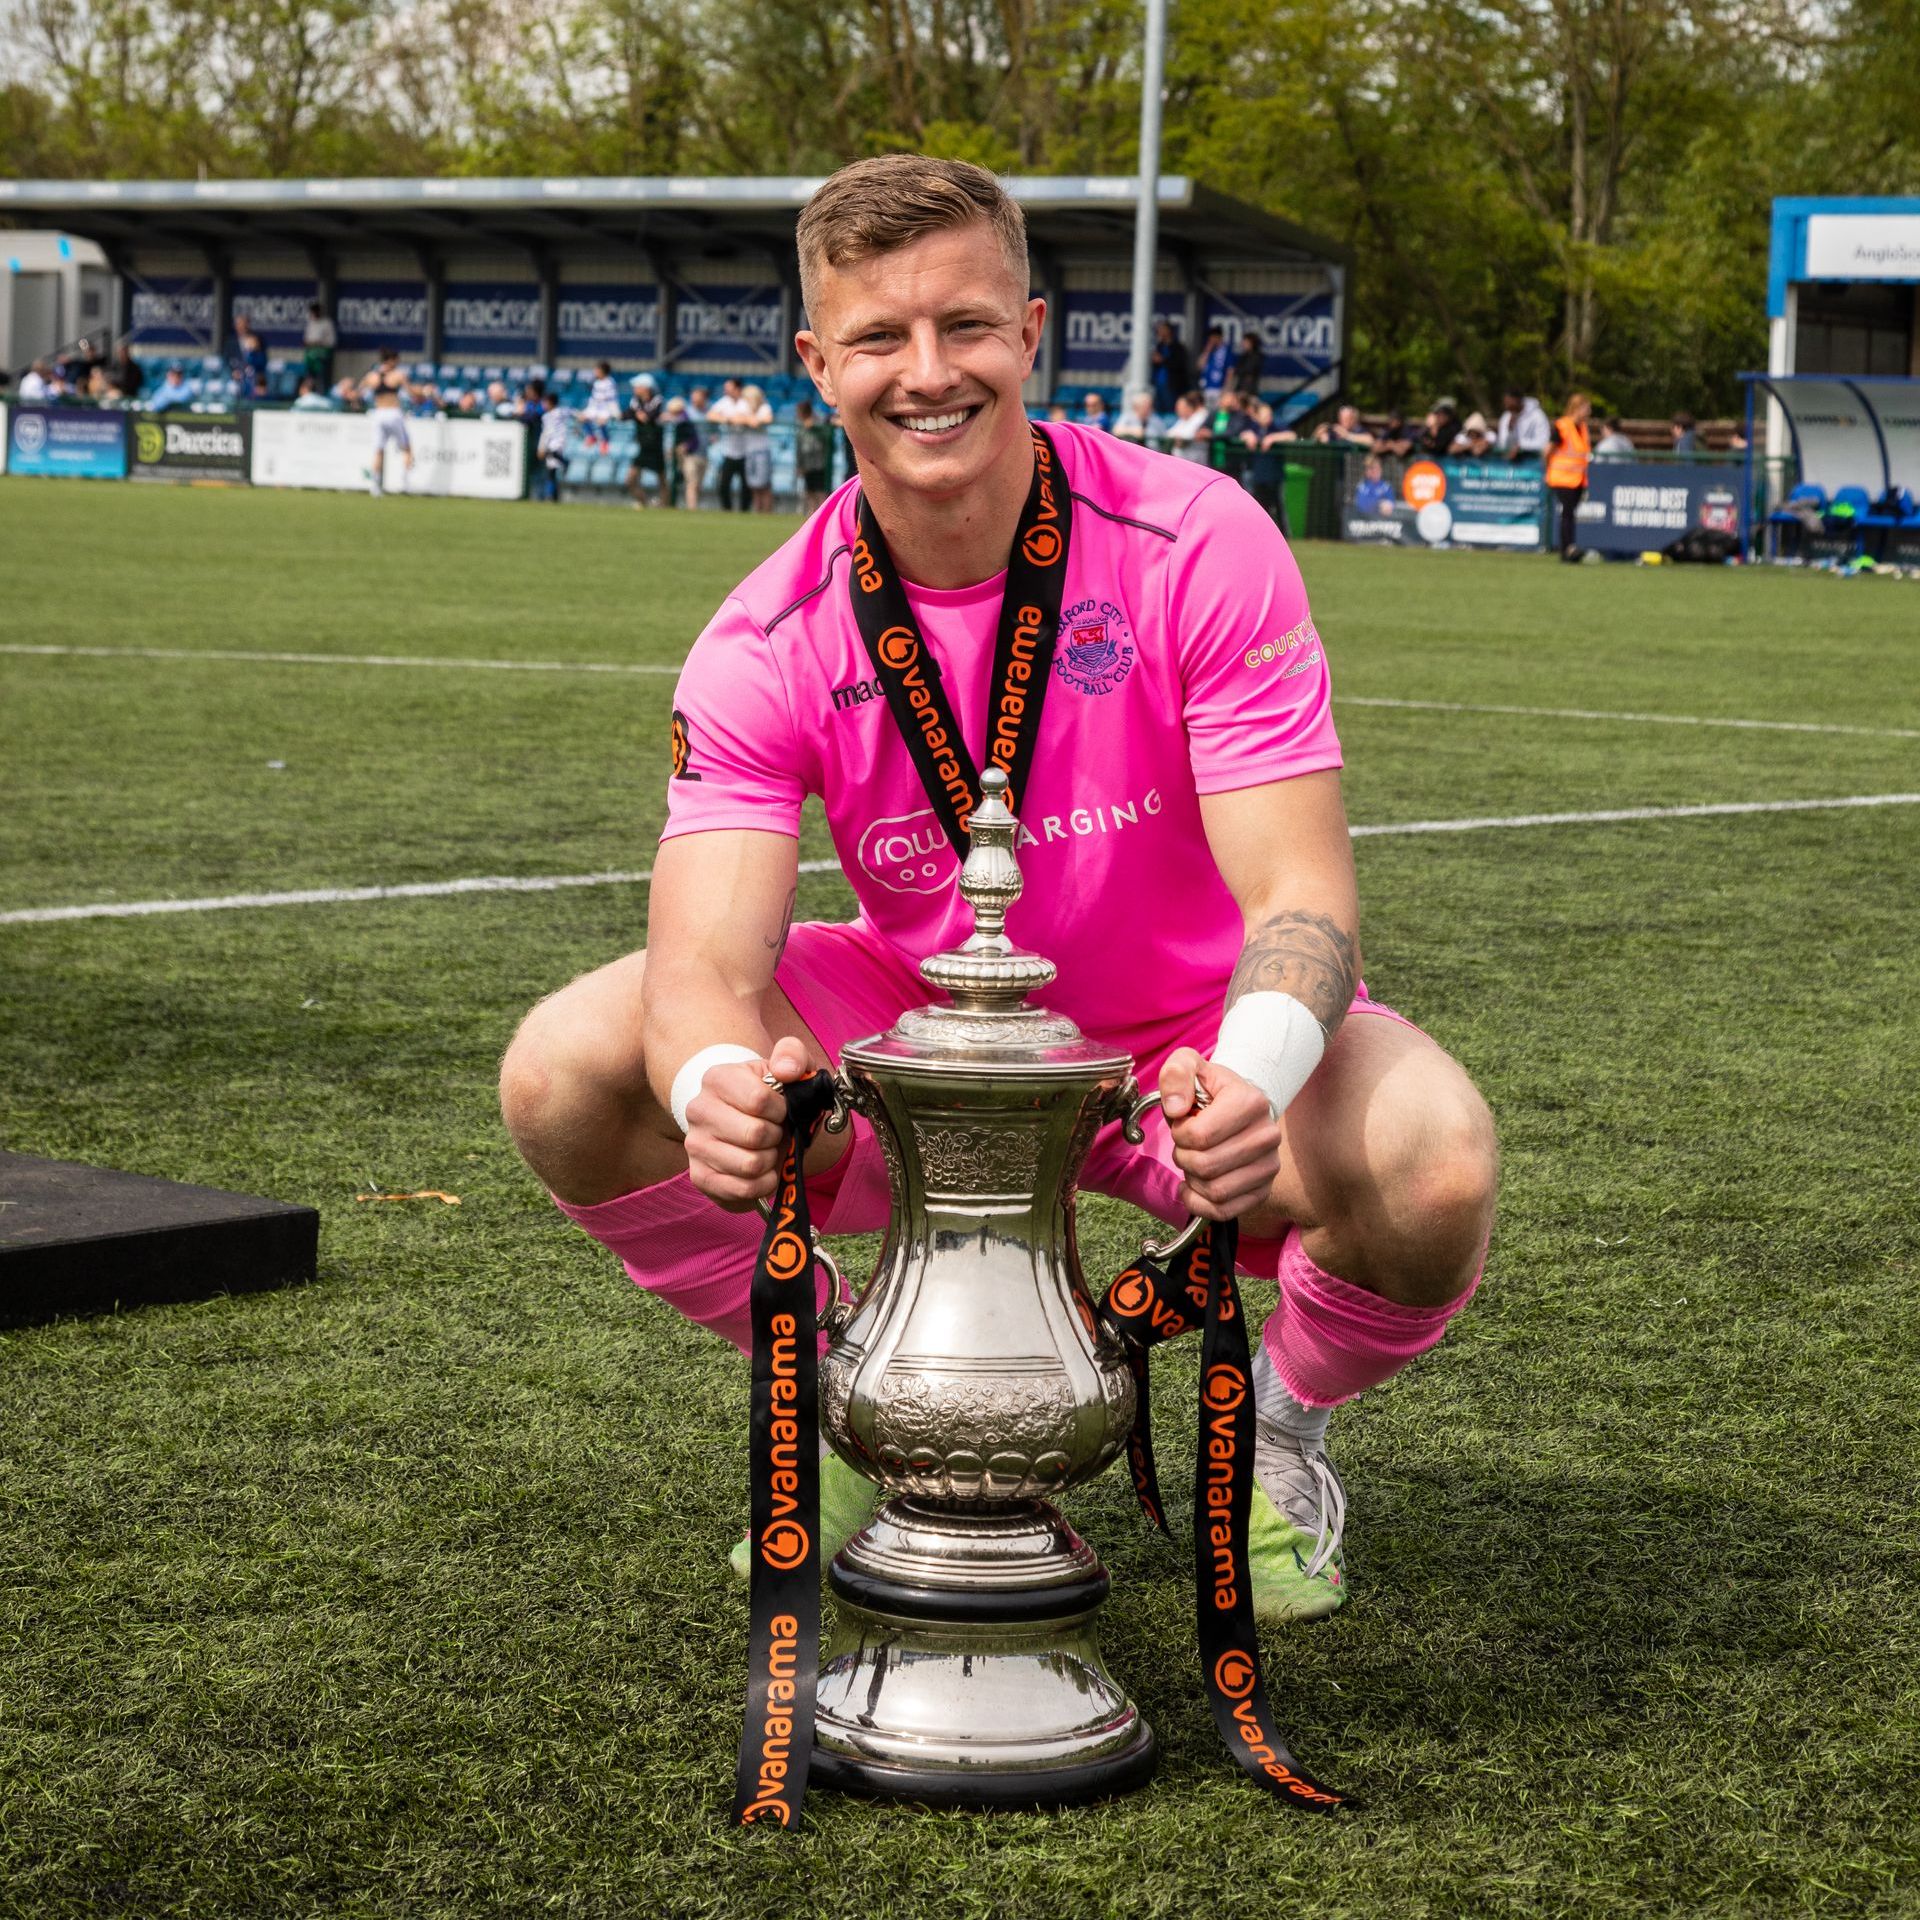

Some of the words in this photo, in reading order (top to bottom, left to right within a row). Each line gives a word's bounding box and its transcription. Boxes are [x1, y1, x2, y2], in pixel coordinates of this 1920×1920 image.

[1052, 657, 1114, 695] FOOTBALL
[1113, 646, 1134, 682] CLUB
[1100, 602, 1126, 627] CITY
[873, 828, 949, 866] raw
[770, 1313, 799, 1514] vanarama
[1207, 1414, 1237, 1610] vanarama
[757, 1614, 799, 1800] vanarama
